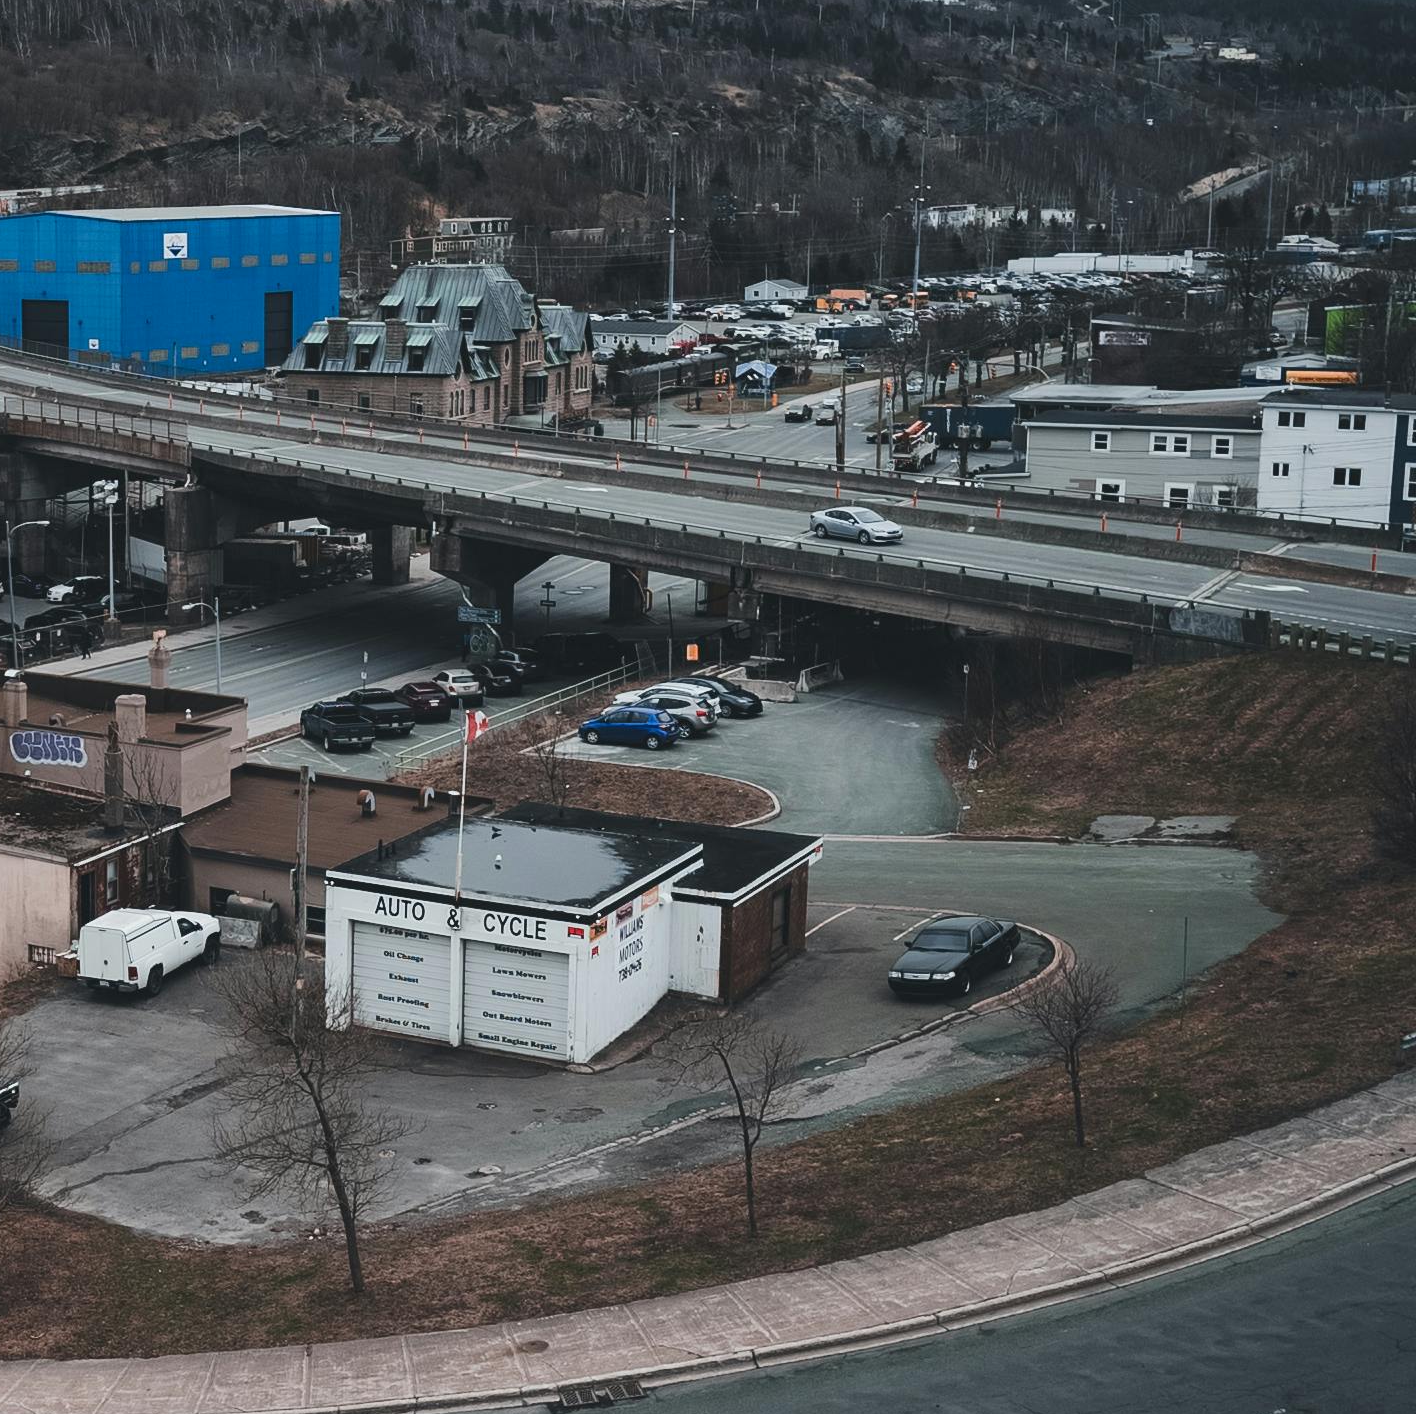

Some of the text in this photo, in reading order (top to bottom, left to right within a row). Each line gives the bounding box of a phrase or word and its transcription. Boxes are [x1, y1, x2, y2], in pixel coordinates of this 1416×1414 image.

[375, 896, 546, 941] AUTO & CYCLE
[383, 950, 424, 963] Oil Change
[619, 935, 644, 964] MOTORS
[388, 973, 419, 984] Exhaust
[492, 966, 547, 981] Lawn Mowers
[377, 993, 429, 1008] Rust Proofing
[491, 989, 544, 1004] Snowblowers
[375, 1014, 401, 1025] Brakes
[411, 1021, 431, 1031] Tires
[482, 1011, 552, 1028] Out Board Motors
[477, 1032, 557, 1051] Small Engine Repair
